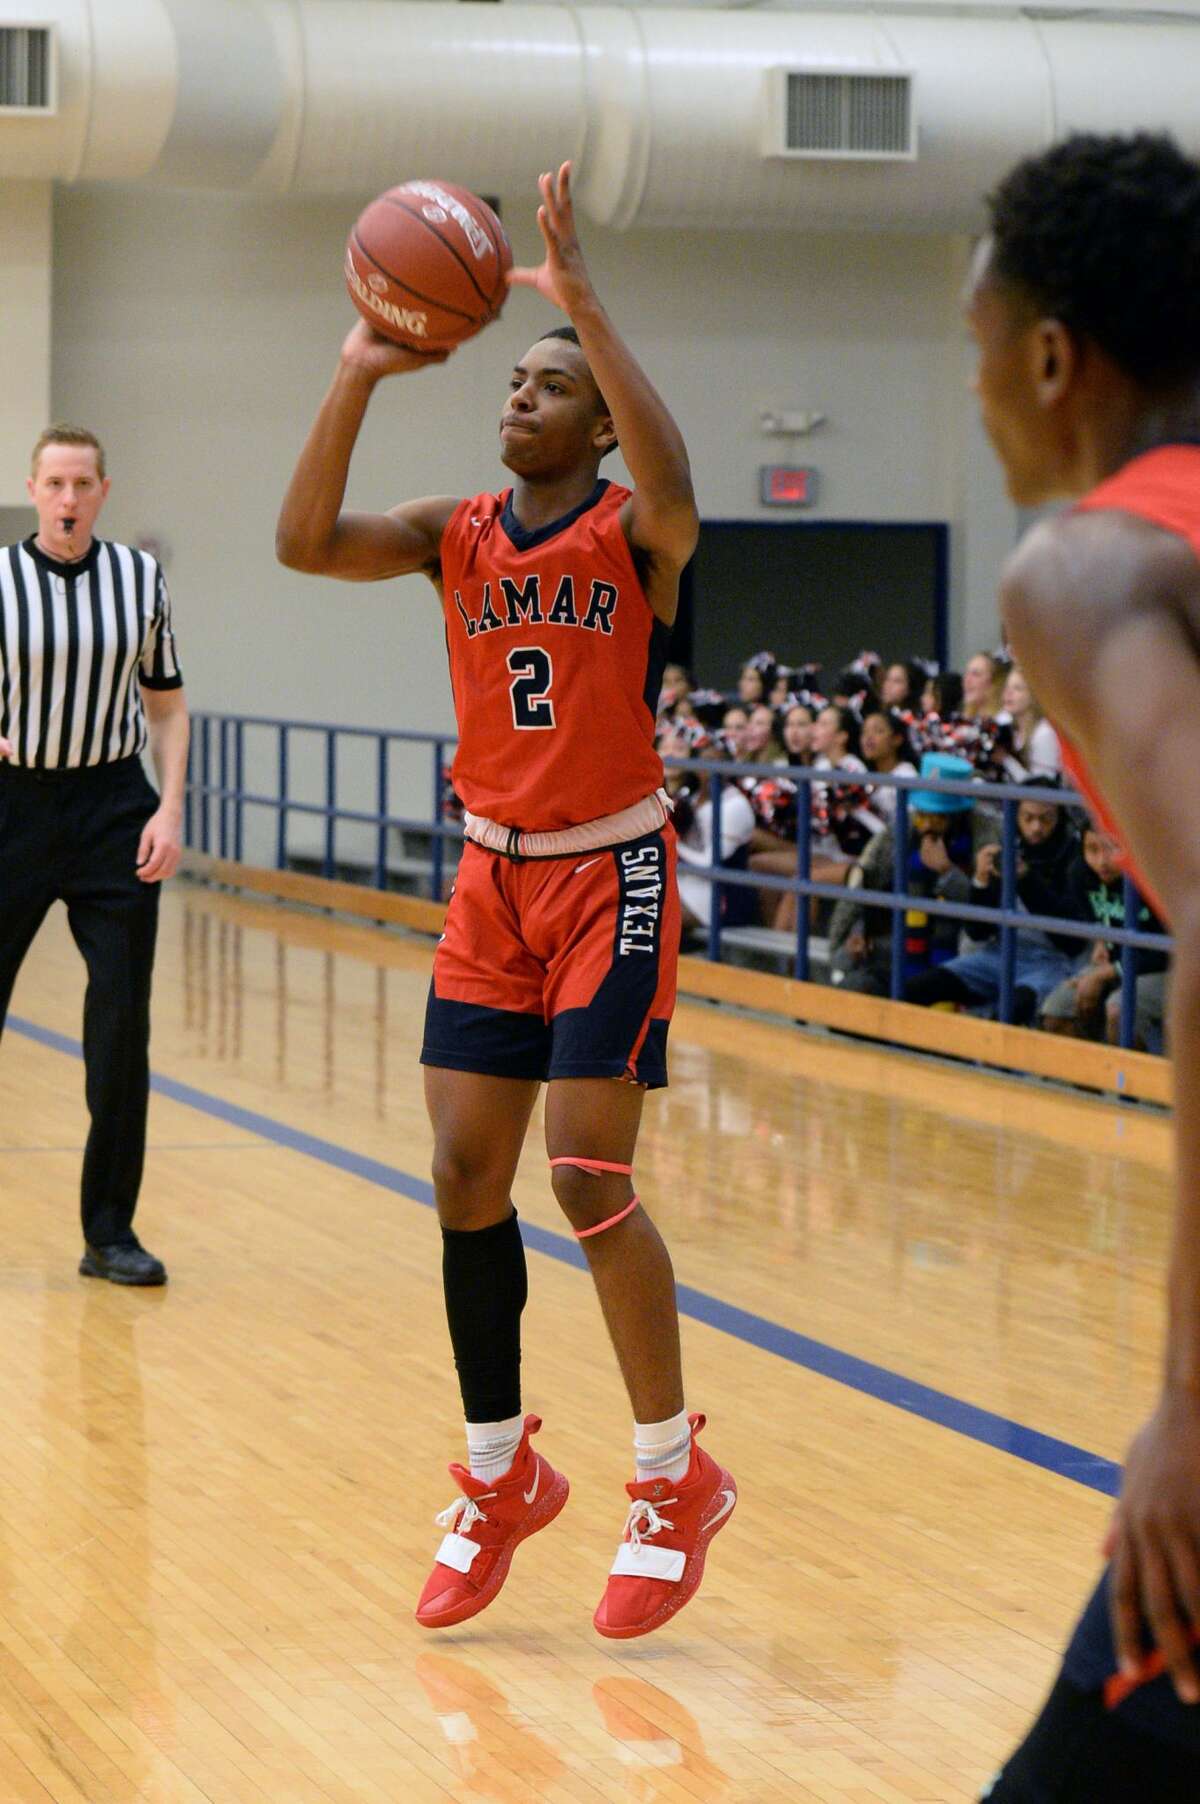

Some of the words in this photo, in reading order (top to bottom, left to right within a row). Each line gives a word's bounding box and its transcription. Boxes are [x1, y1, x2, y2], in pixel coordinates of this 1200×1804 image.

[454, 574, 619, 639] LAMAR
[506, 646, 556, 730] 2
[620, 846, 662, 956] TEXANS
